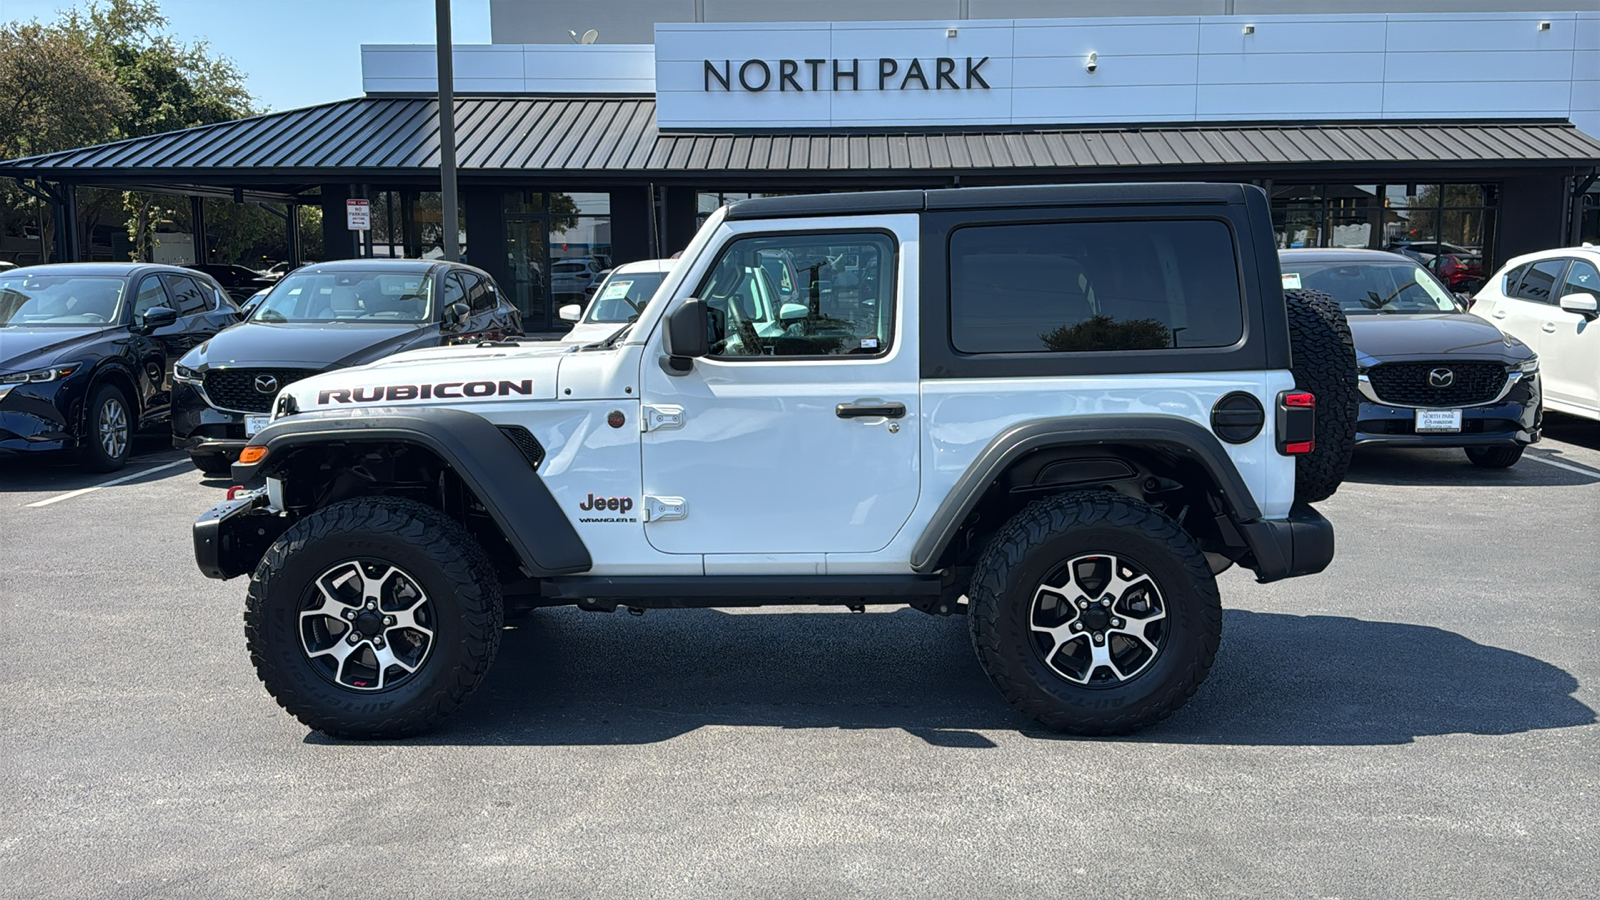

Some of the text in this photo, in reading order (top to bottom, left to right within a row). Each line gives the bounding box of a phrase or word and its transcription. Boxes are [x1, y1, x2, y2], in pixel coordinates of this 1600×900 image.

[704, 56, 990, 92] NORTH PARK
[318, 379, 533, 404] RUBICON
[579, 493, 633, 514] Jeep
